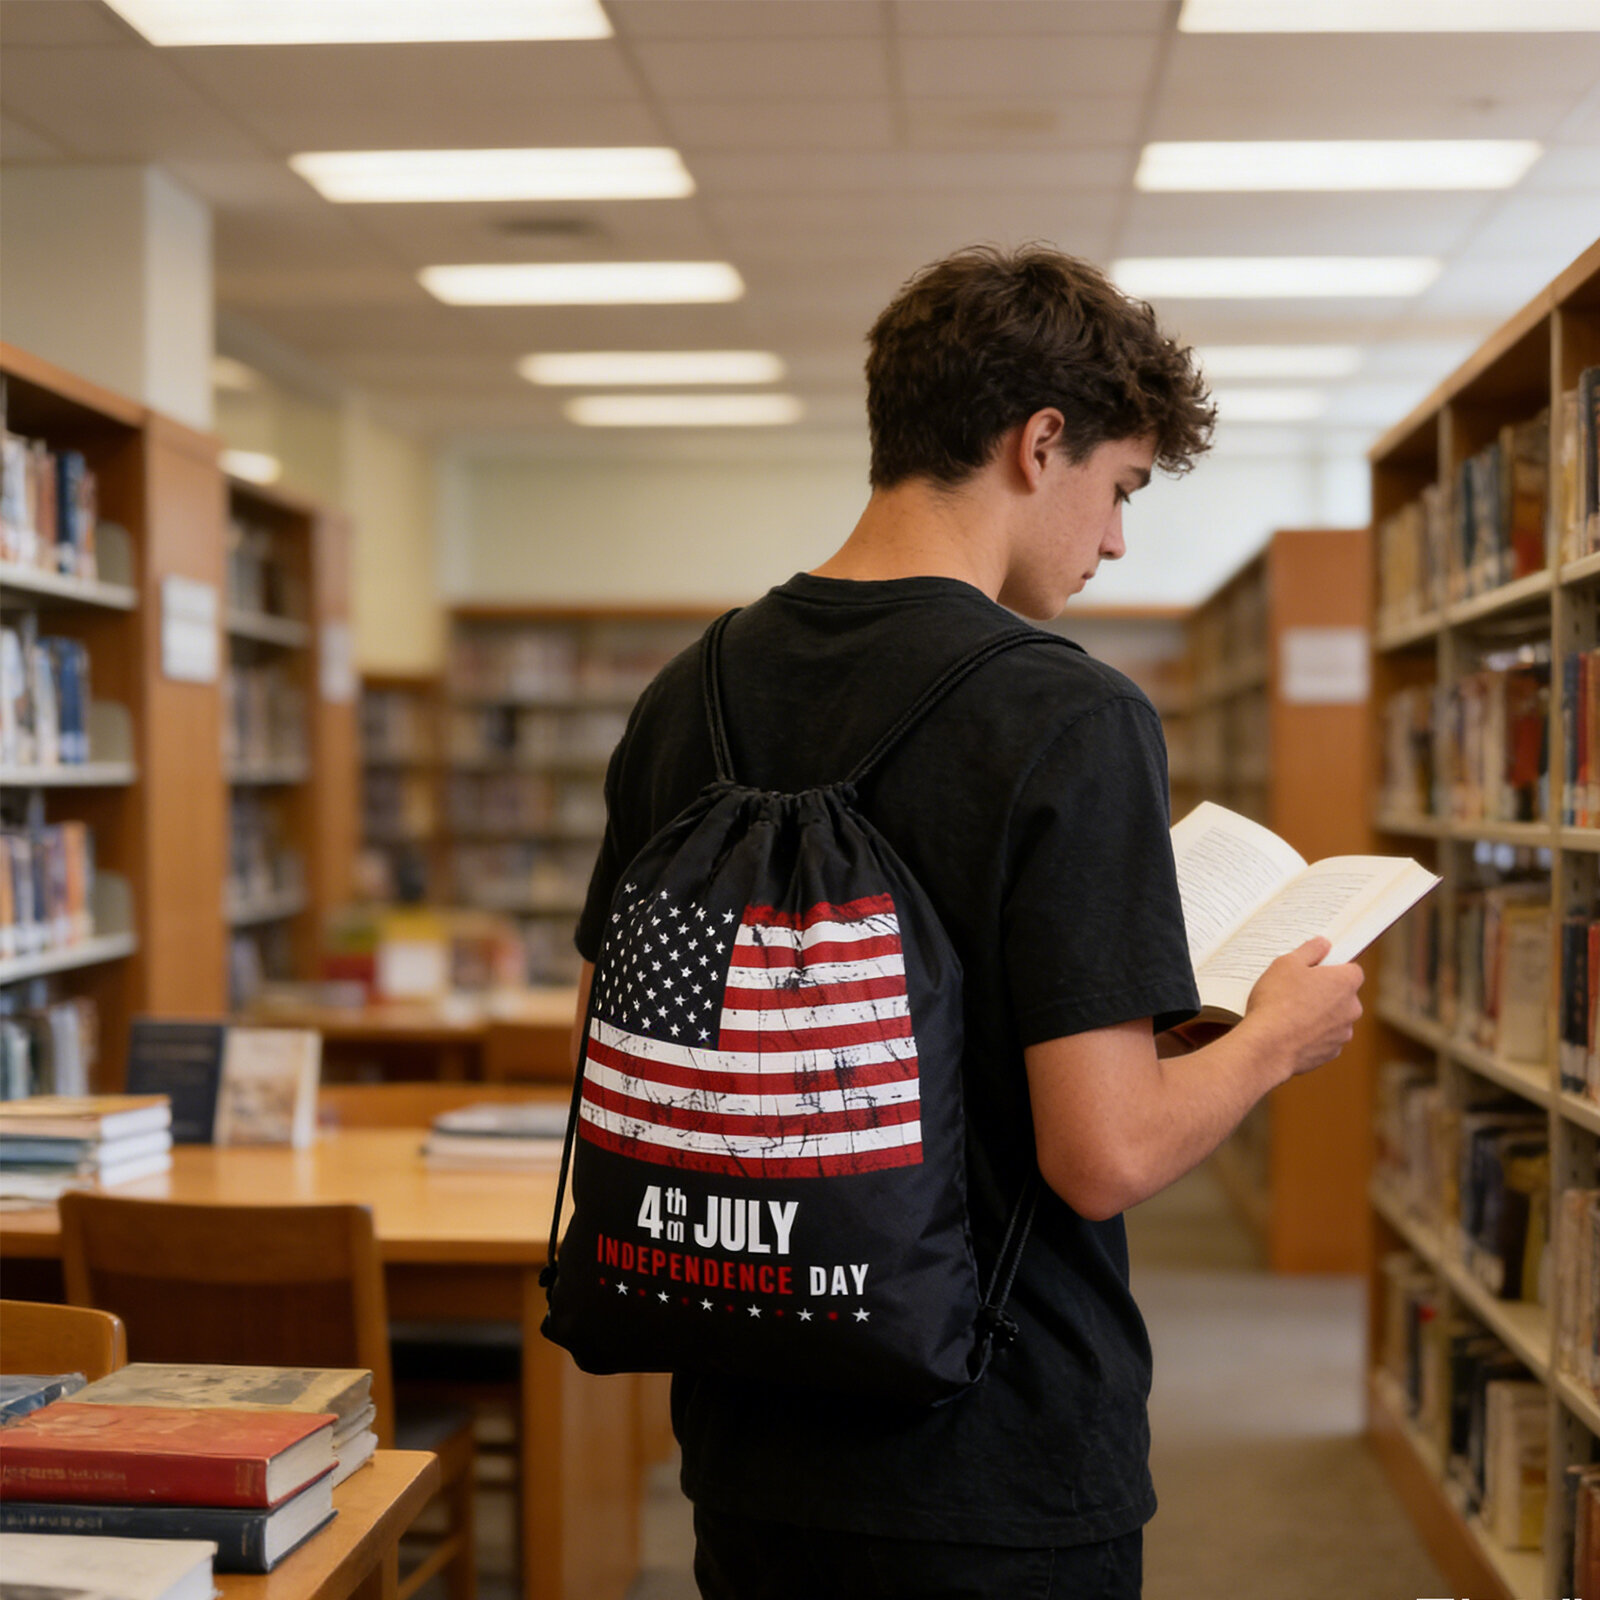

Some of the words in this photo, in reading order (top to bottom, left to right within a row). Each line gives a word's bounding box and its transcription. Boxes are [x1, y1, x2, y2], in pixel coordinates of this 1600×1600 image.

[637, 1185, 687, 1239] 4th
[694, 1196, 799, 1254] JULY
[597, 1233, 793, 1294] INDEPENDENCE
[809, 1264, 869, 1296] DAY
